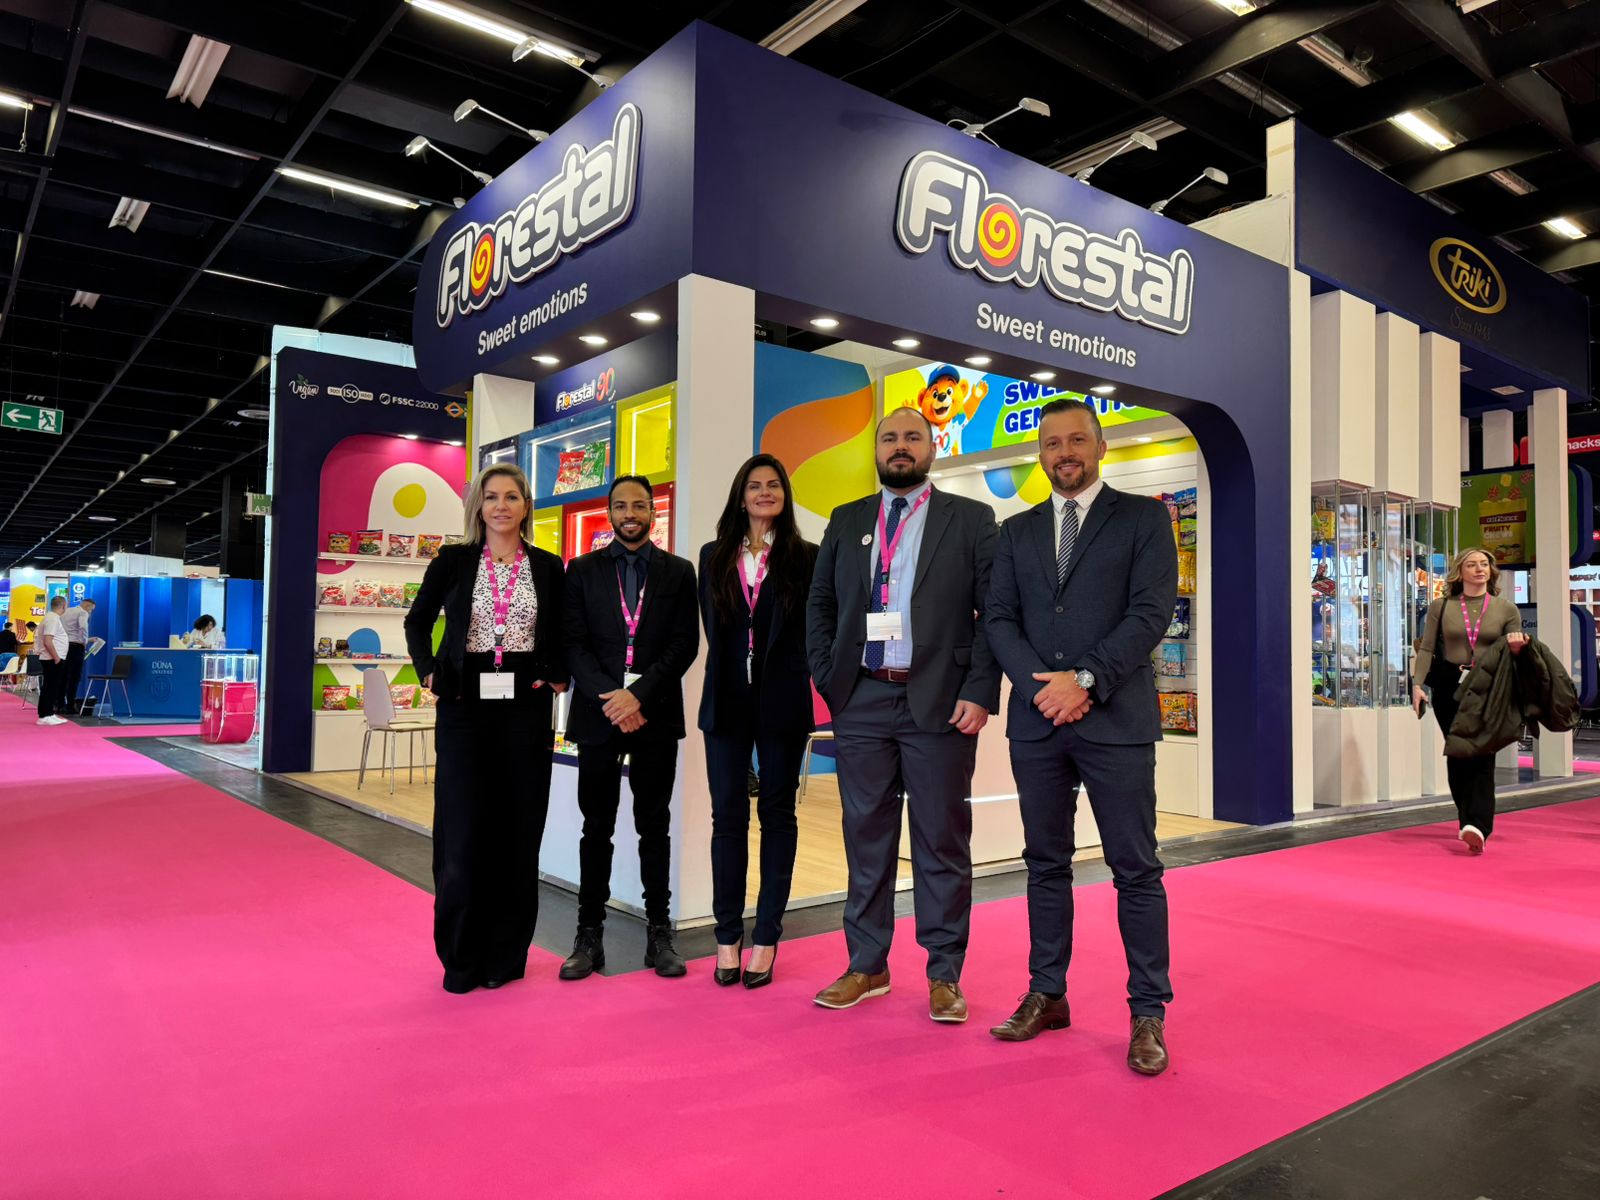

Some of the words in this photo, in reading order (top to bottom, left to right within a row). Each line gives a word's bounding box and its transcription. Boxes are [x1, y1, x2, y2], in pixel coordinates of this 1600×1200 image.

[438, 108, 633, 318] Florestal
[904, 156, 1191, 326] Florestal
[478, 316, 517, 355] Sweet
[520, 282, 588, 334] emotions
[976, 302, 1044, 344] Sweet
[1049, 329, 1137, 368] emotions
[343, 388, 359, 398] ISO
[392, 396, 415, 407] FSSC
[415, 400, 439, 410] 22000
[555, 379, 597, 413] Florestal
[1004, 381, 1064, 405] SWE
